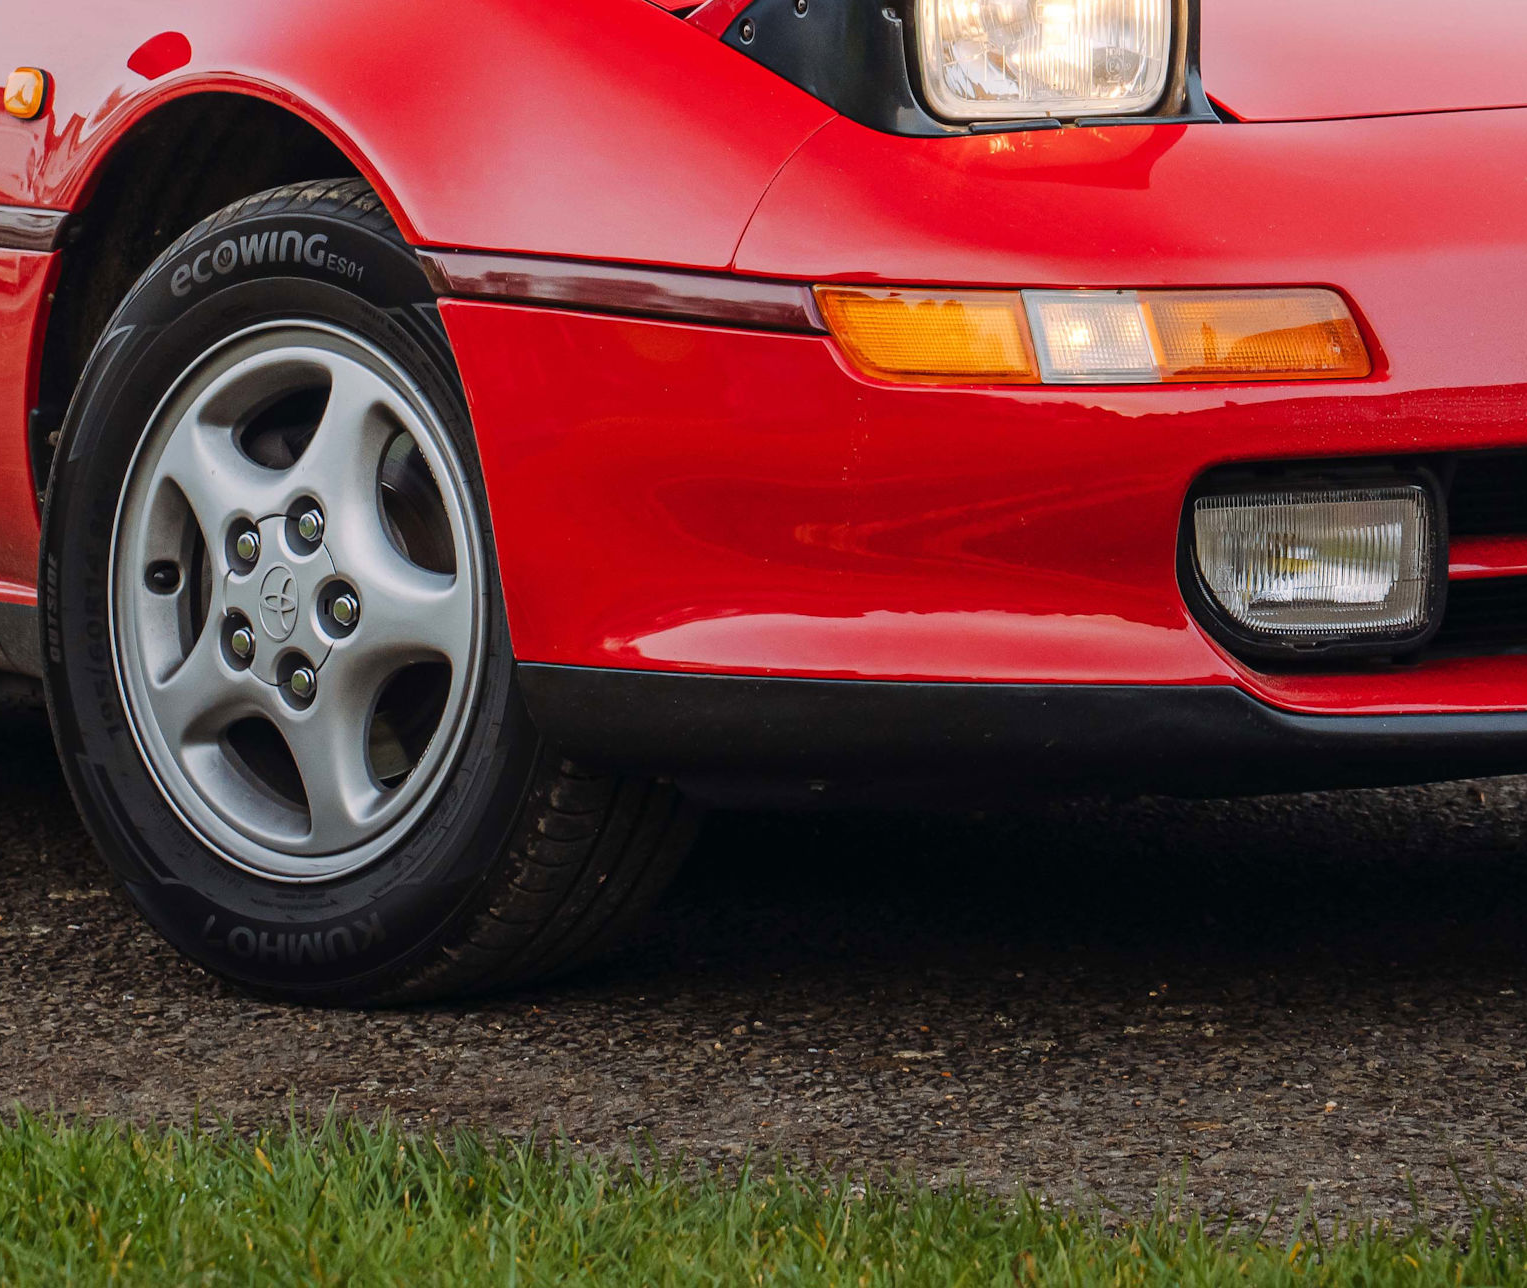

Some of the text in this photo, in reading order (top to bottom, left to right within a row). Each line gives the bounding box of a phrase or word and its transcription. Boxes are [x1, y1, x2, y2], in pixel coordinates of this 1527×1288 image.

[327, 253, 364, 282] ES01
[47, 551, 62, 664] OUTSIDE
[226, 912, 386, 965] KUMHO
